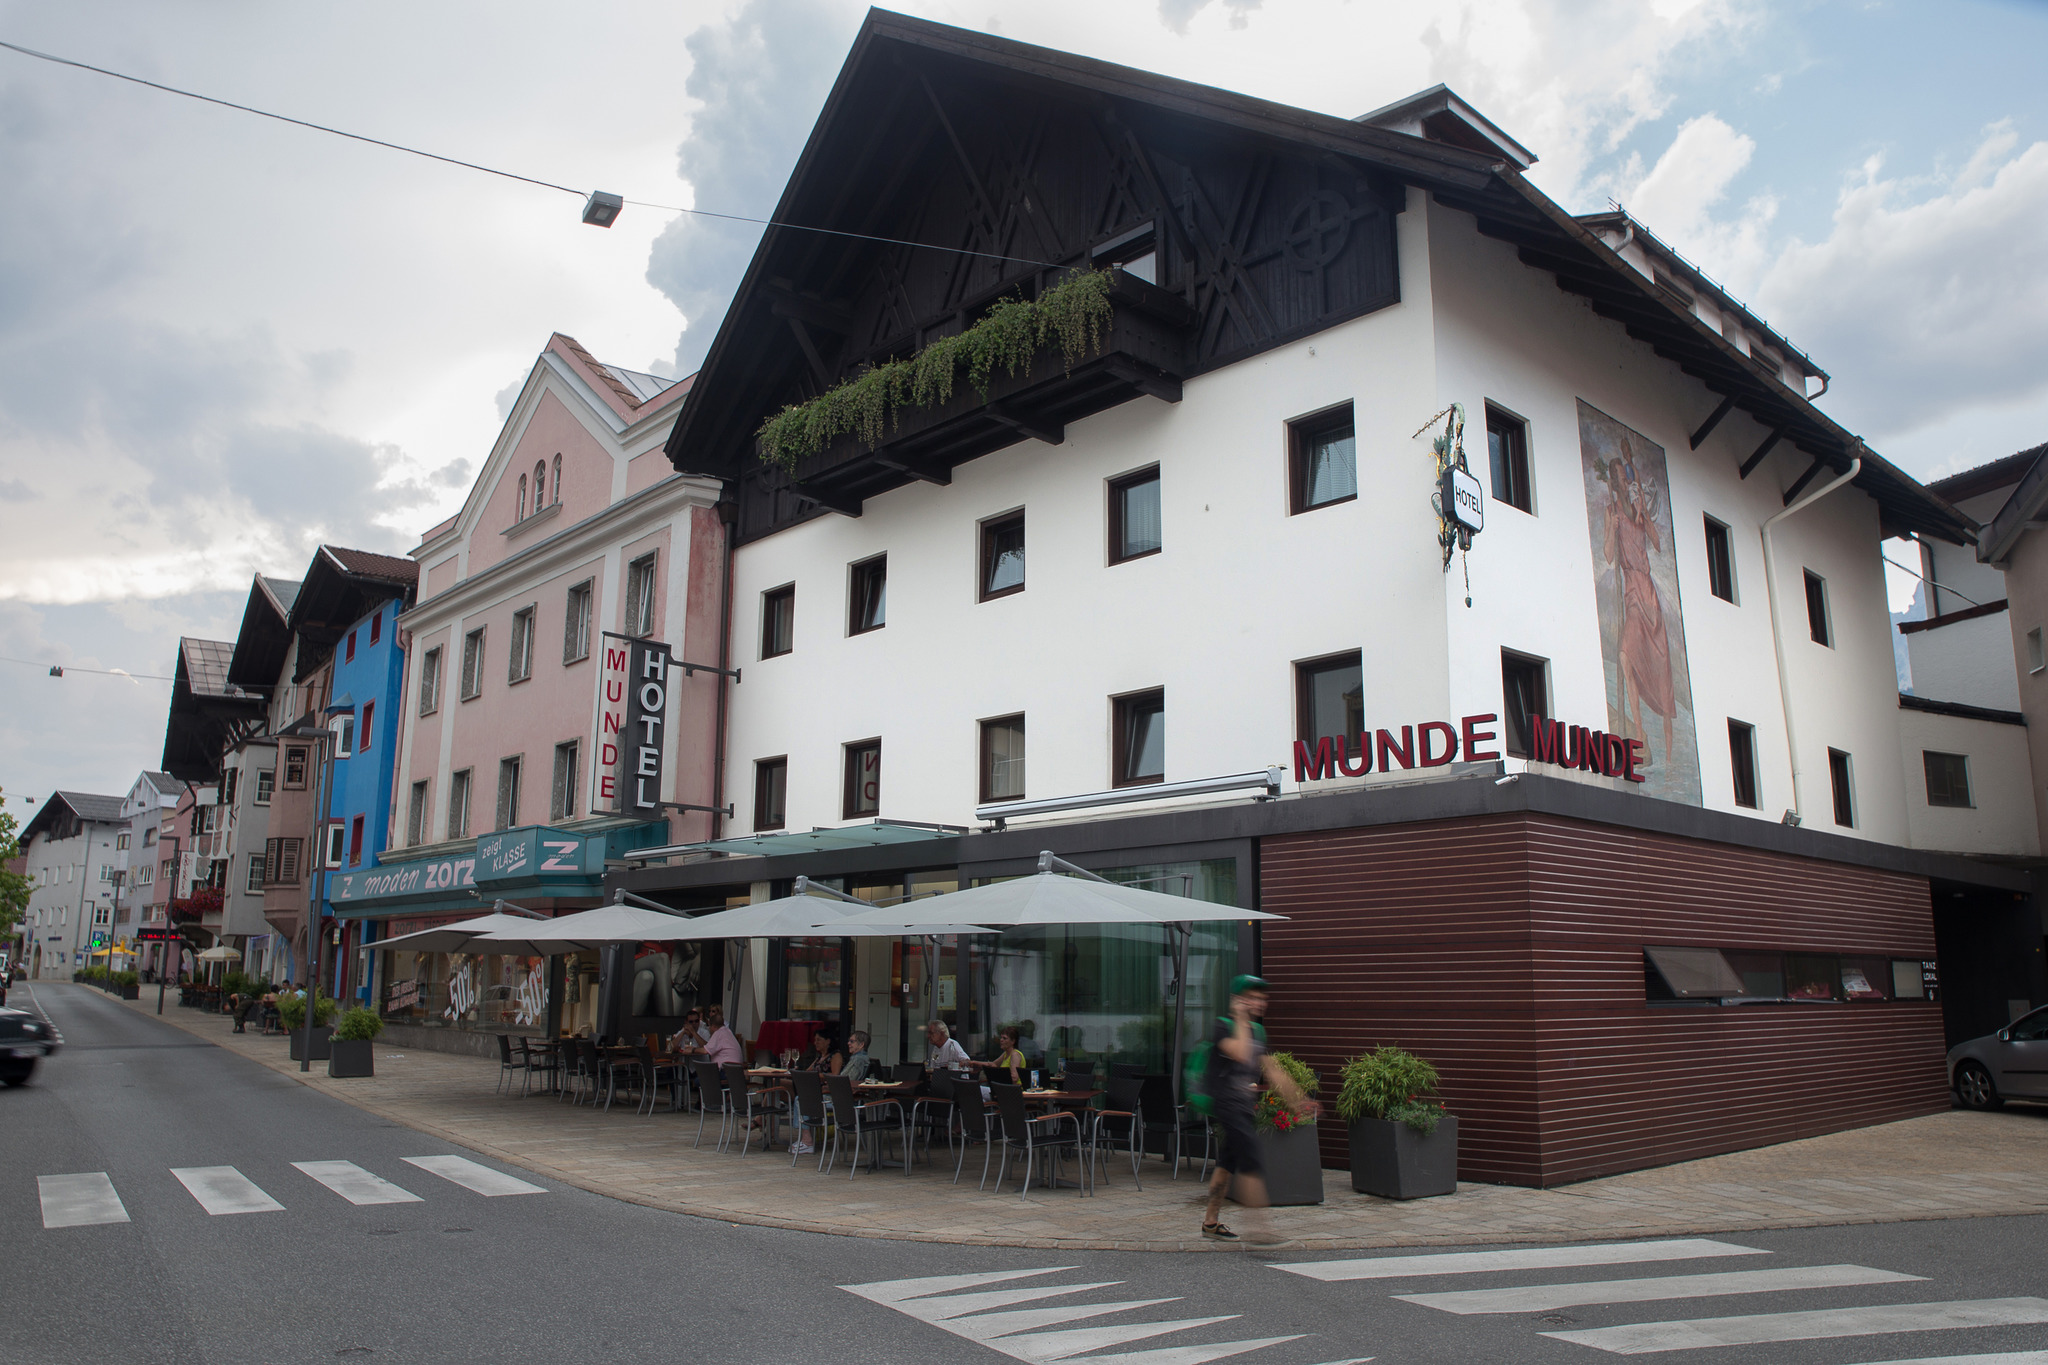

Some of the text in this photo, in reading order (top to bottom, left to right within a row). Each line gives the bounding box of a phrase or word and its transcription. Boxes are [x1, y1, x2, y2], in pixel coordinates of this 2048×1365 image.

[1455, 485, 1481, 515] HOTEL
[600, 648, 626, 799] MUNDE
[636, 649, 665, 809] HOTEL
[1293, 713, 1501, 782] MUNDE
[1527, 713, 1646, 783] MUNDE
[482, 837, 502, 859] zeigt
[493, 842, 526, 872] KLASSE
[364, 867, 420, 895] moden
[1922, 961, 1937, 970] TANZ
[1922, 972, 1938, 981] LOKAL
[444, 962, 475, 1021] -50%
[515, 957, 550, 1026] -50%
